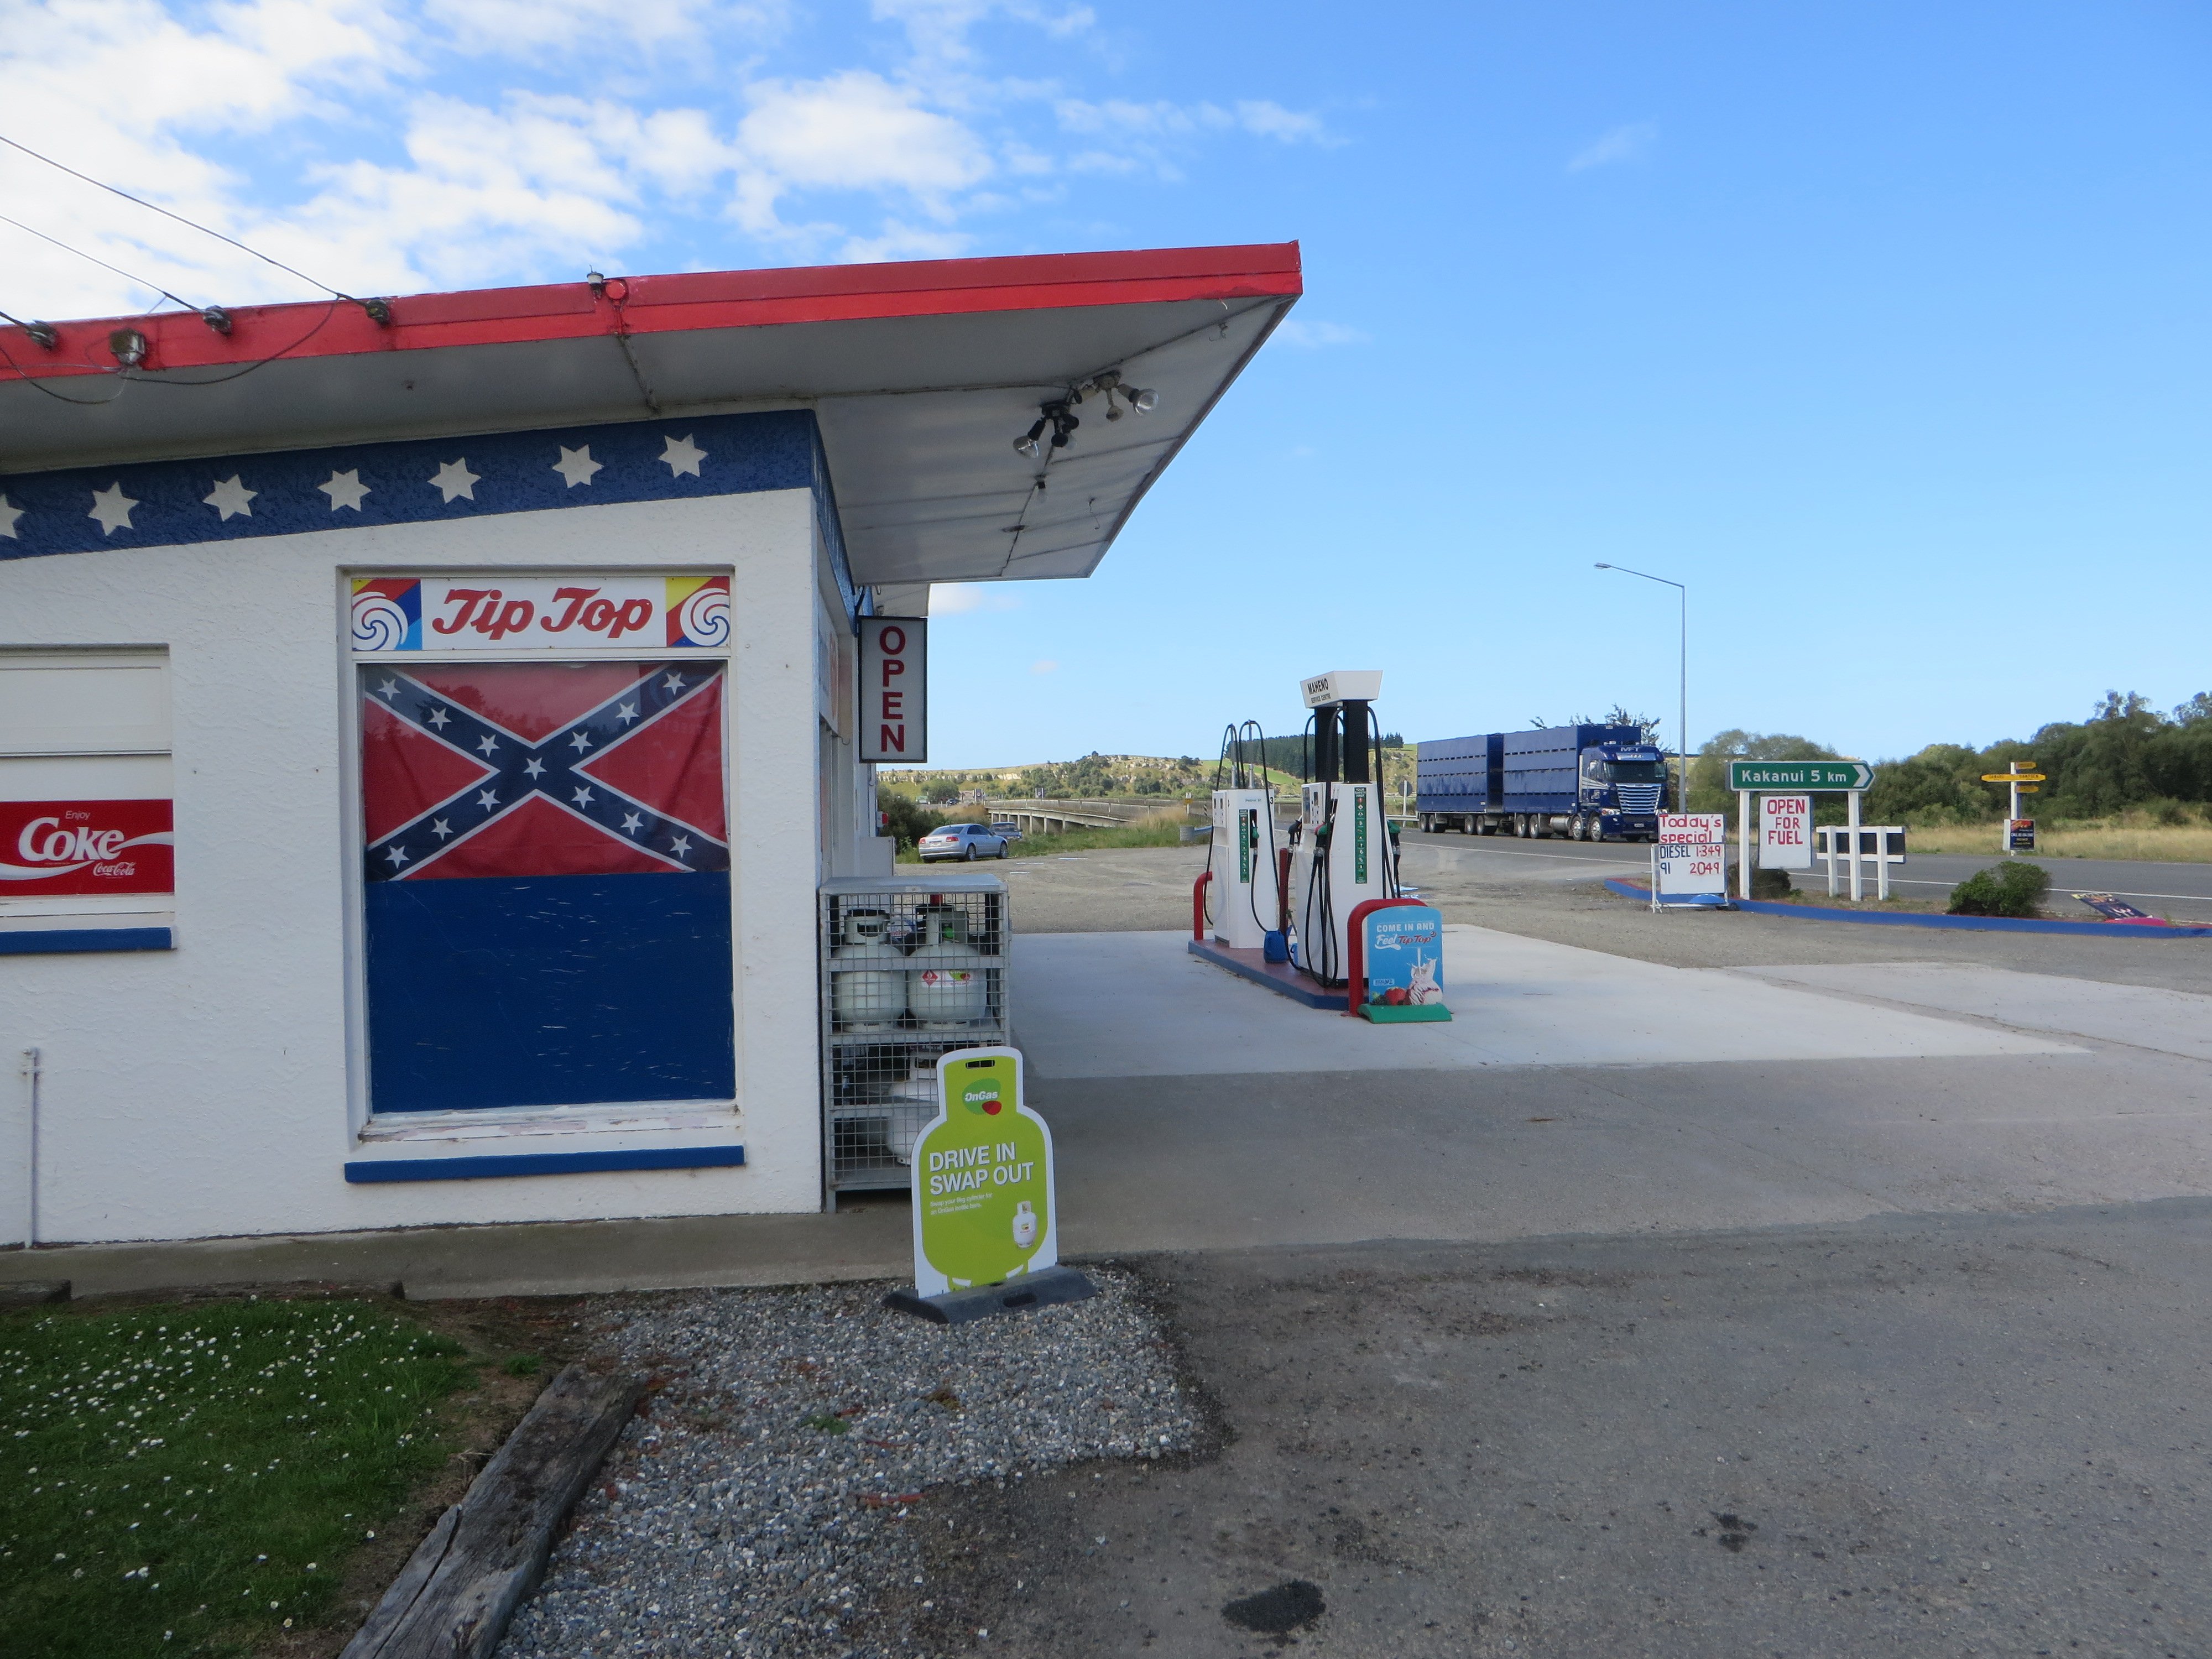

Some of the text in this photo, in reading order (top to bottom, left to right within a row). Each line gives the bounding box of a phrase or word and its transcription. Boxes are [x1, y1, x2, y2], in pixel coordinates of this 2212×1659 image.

[431, 587, 654, 640] Tip Top
[879, 625, 906, 753] OPEN
[1307, 678, 1329, 695] MAHENO
[1741, 770, 1847, 782] Kakanui 5 km
[1270, 796, 1274, 805] 3
[1767, 799, 1806, 815] OPEN
[65, 810, 90, 820] Enjoy
[1659, 814, 1721, 832] Today's
[1775, 817, 1801, 829] FOR
[18, 817, 125, 862] Coke
[1661, 830, 1712, 844] special
[1768, 830, 1803, 845] FUEL
[1660, 845, 1691, 859] DIESEL
[1660, 862, 1671, 874] 91
[1376, 924, 1401, 932] COME
[1376, 933, 1398, 945] Feel
[964, 1091, 998, 1102] OnGas
[929, 1142, 1016, 1172] DRIVE IN
[930, 1162, 1035, 1195] SWAP OUT
